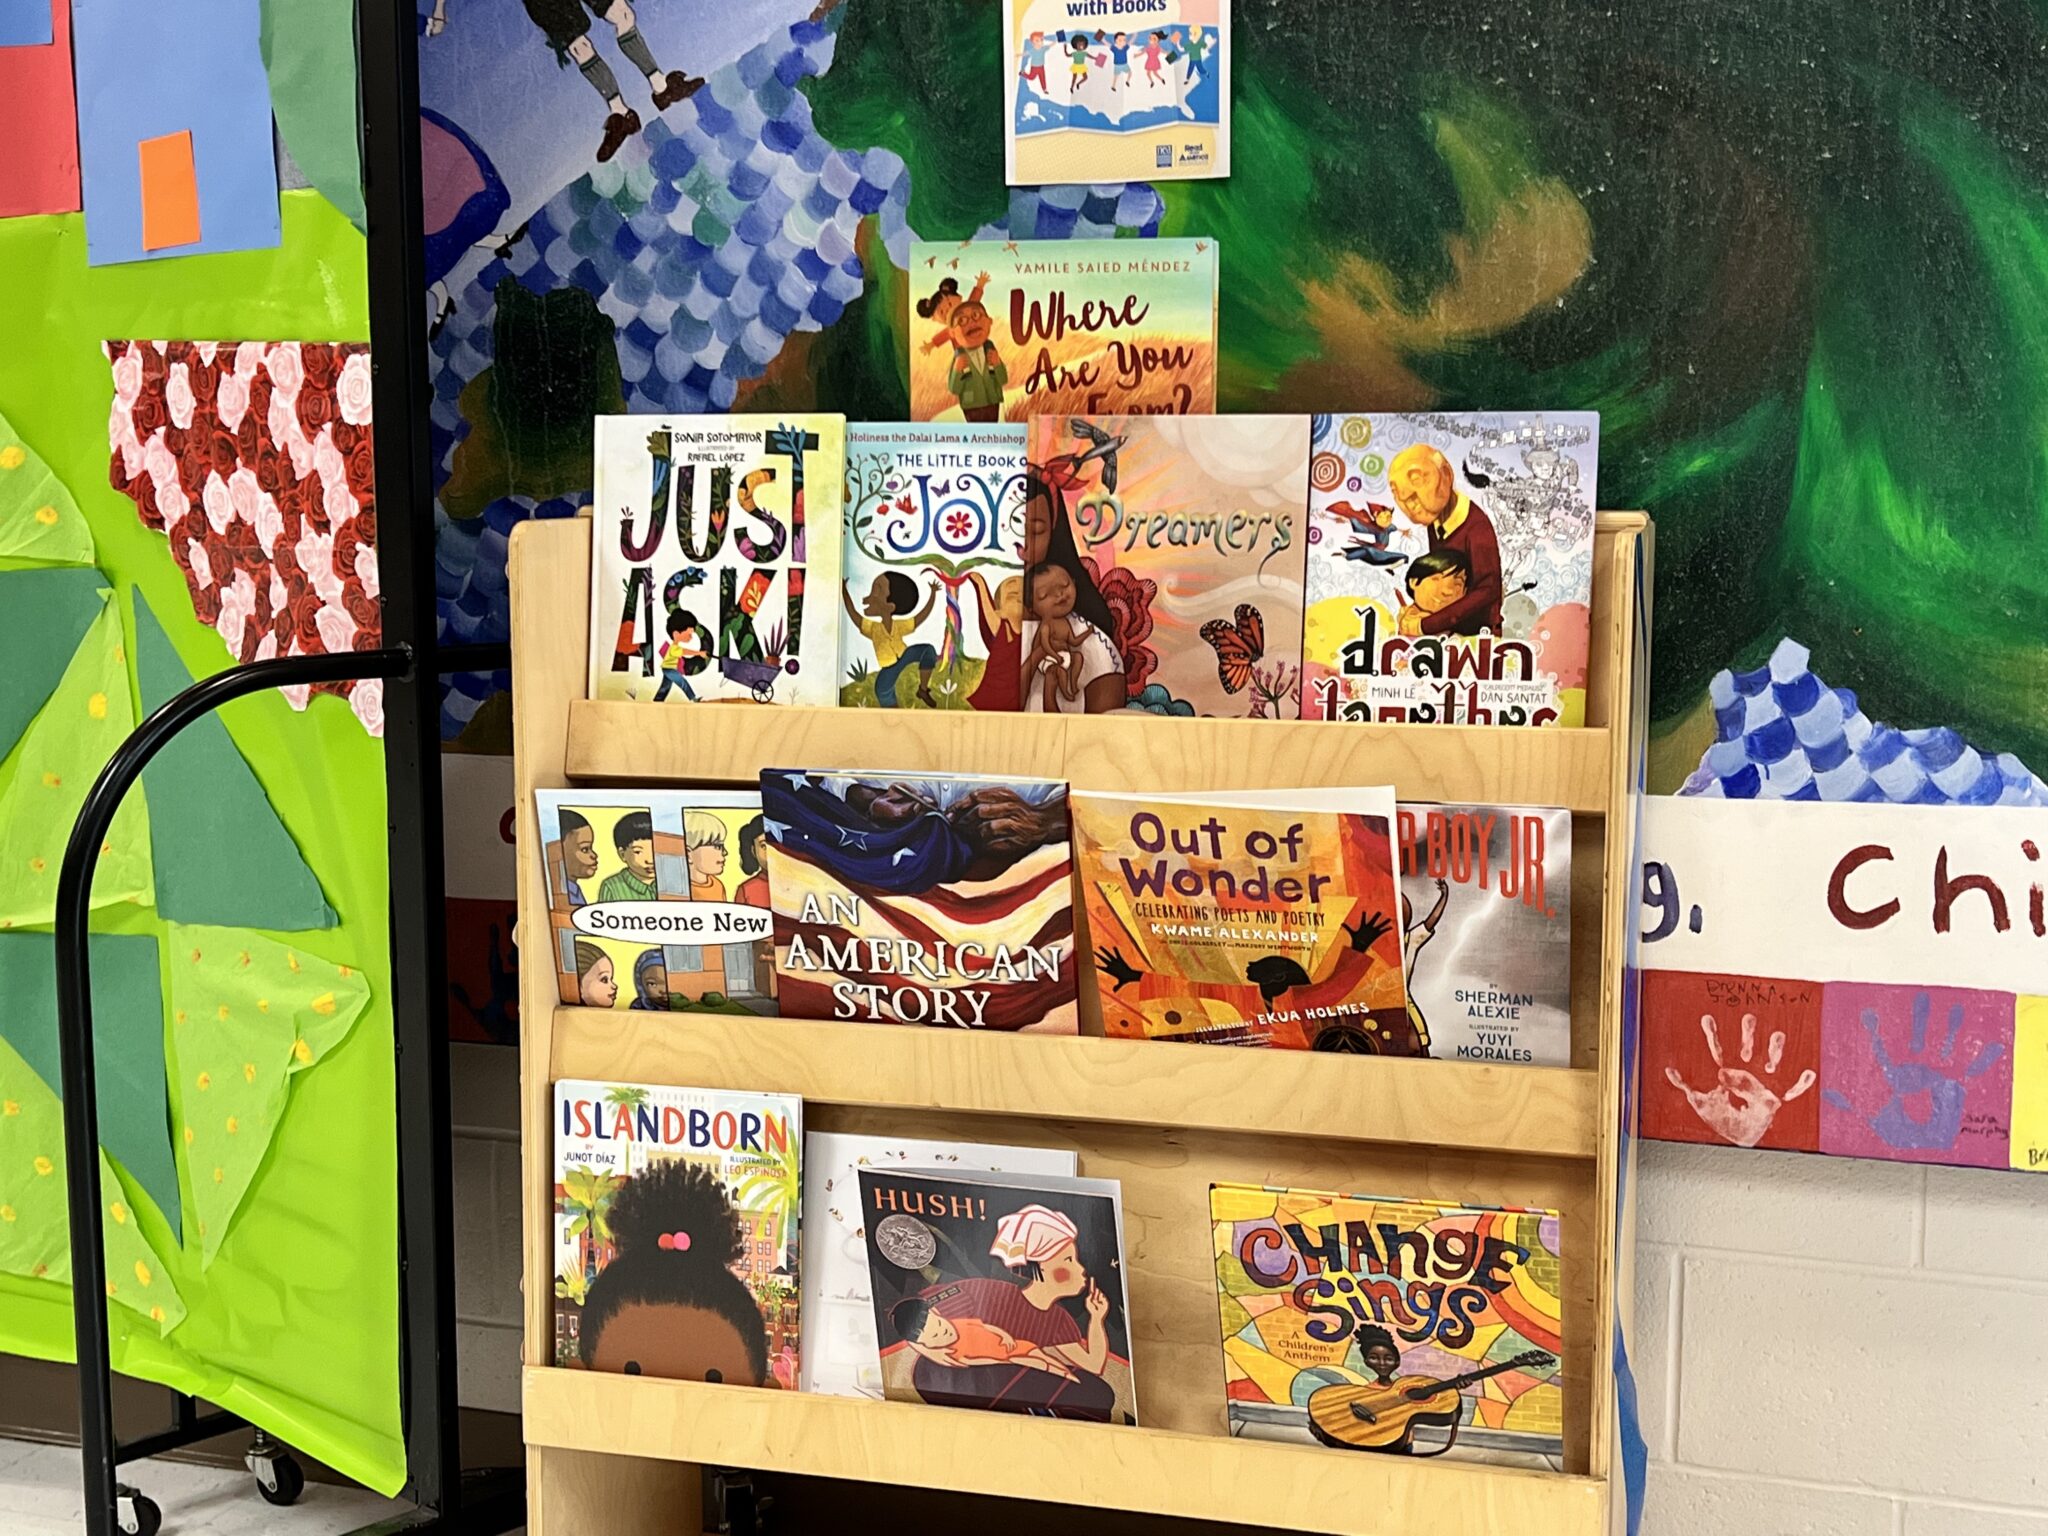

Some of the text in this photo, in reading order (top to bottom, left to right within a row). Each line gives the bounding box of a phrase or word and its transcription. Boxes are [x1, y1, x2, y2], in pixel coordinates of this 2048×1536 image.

[1066, 0, 1167, 16] with Books
[1014, 257, 1191, 274] YAMILE SAIED MÉNDEZ
[1010, 288, 1149, 346] Where
[1026, 341, 1194, 394] Are You
[675, 432, 762, 443] SONIA SOTOMAYOR
[850, 432, 889, 442] Holiness
[892, 432, 906, 442] the
[909, 432, 932, 442] Dalai
[935, 433, 960, 443] Lama
[971, 433, 1026, 446] Archbishop
[688, 452, 717, 462] RAFAEL
[896, 454, 923, 467] THE
[978, 454, 1016, 468] BOOK
[619, 428, 819, 563] JUST
[887, 473, 1027, 554] JOY
[1075, 494, 1293, 580] Dreamers
[611, 566, 807, 678] ASK!
[1341, 606, 1534, 681] drawn
[1371, 686, 1401, 699] MINH
[1481, 691, 1547, 704] DAN SANTAT
[1130, 812, 1304, 863] Out of
[1427, 812, 1496, 890] BOY
[1500, 815, 1556, 920] JR.
[1119, 857, 1331, 904] Wonder
[799, 893, 860, 925] AN
[1135, 902, 1325, 928] CELEBRATING POETS AND POETRY
[590, 910, 767, 933] Someone New
[1150, 922, 1319, 944] KWAME ALEXANDER
[784, 933, 1063, 983] AMERICAN
[832, 982, 991, 1029] STORY
[1455, 989, 1533, 1006] SHERMAN
[1257, 1002, 1370, 1025] EKUA HOLMES
[1467, 1004, 1520, 1020] ALEXIE
[1476, 1032, 1512, 1047] YUYI
[1457, 1044, 1532, 1062] MORALES
[563, 1098, 787, 1153] ISLANDBORN
[564, 1151, 592, 1163] JUNOT
[724, 1164, 787, 1179] LEO ESPINOSA
[873, 1187, 986, 1221] HUSH!
[1278, 1339, 1335, 1353] Children's
[1291, 1330, 1300, 1340] A
[1283, 1350, 1330, 1362] Anthem
